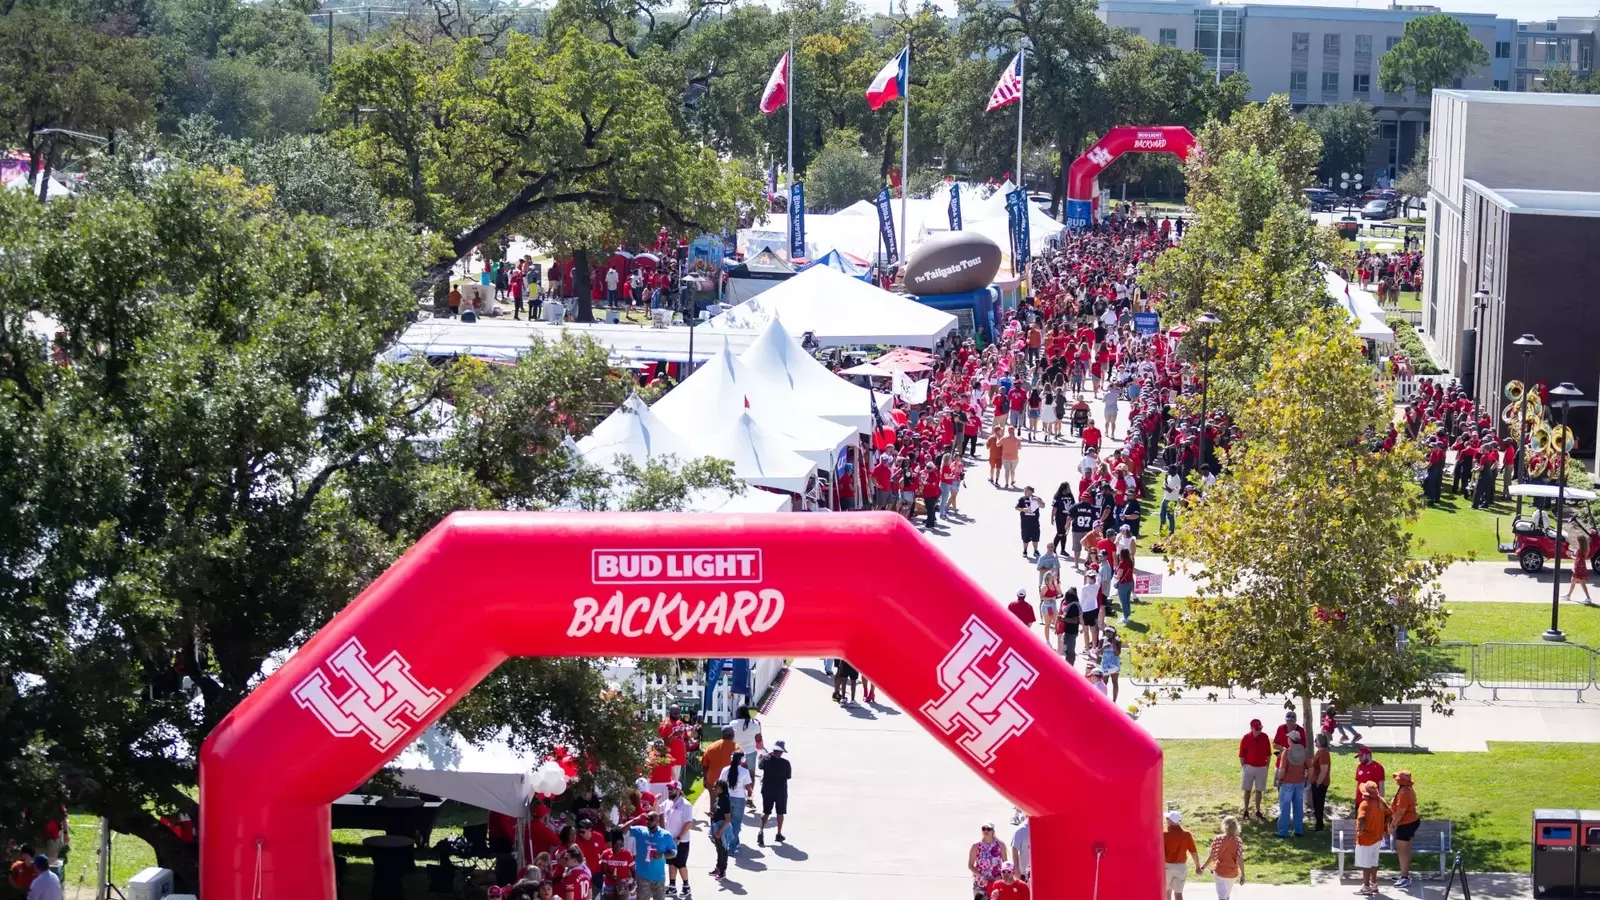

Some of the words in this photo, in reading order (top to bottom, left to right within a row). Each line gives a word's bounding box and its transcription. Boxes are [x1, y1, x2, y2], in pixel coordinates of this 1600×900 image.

[1133, 139, 1167, 149] BACKYARD
[1066, 217, 1087, 227] BUD
[914, 275, 925, 284] The
[924, 264, 961, 281] Tailgate
[959, 256, 982, 270] Tour
[598, 555, 662, 578] BUD
[667, 554, 755, 577] LIGHT
[566, 588, 786, 642] BACKYARD
[579, 880, 590, 898] 10
